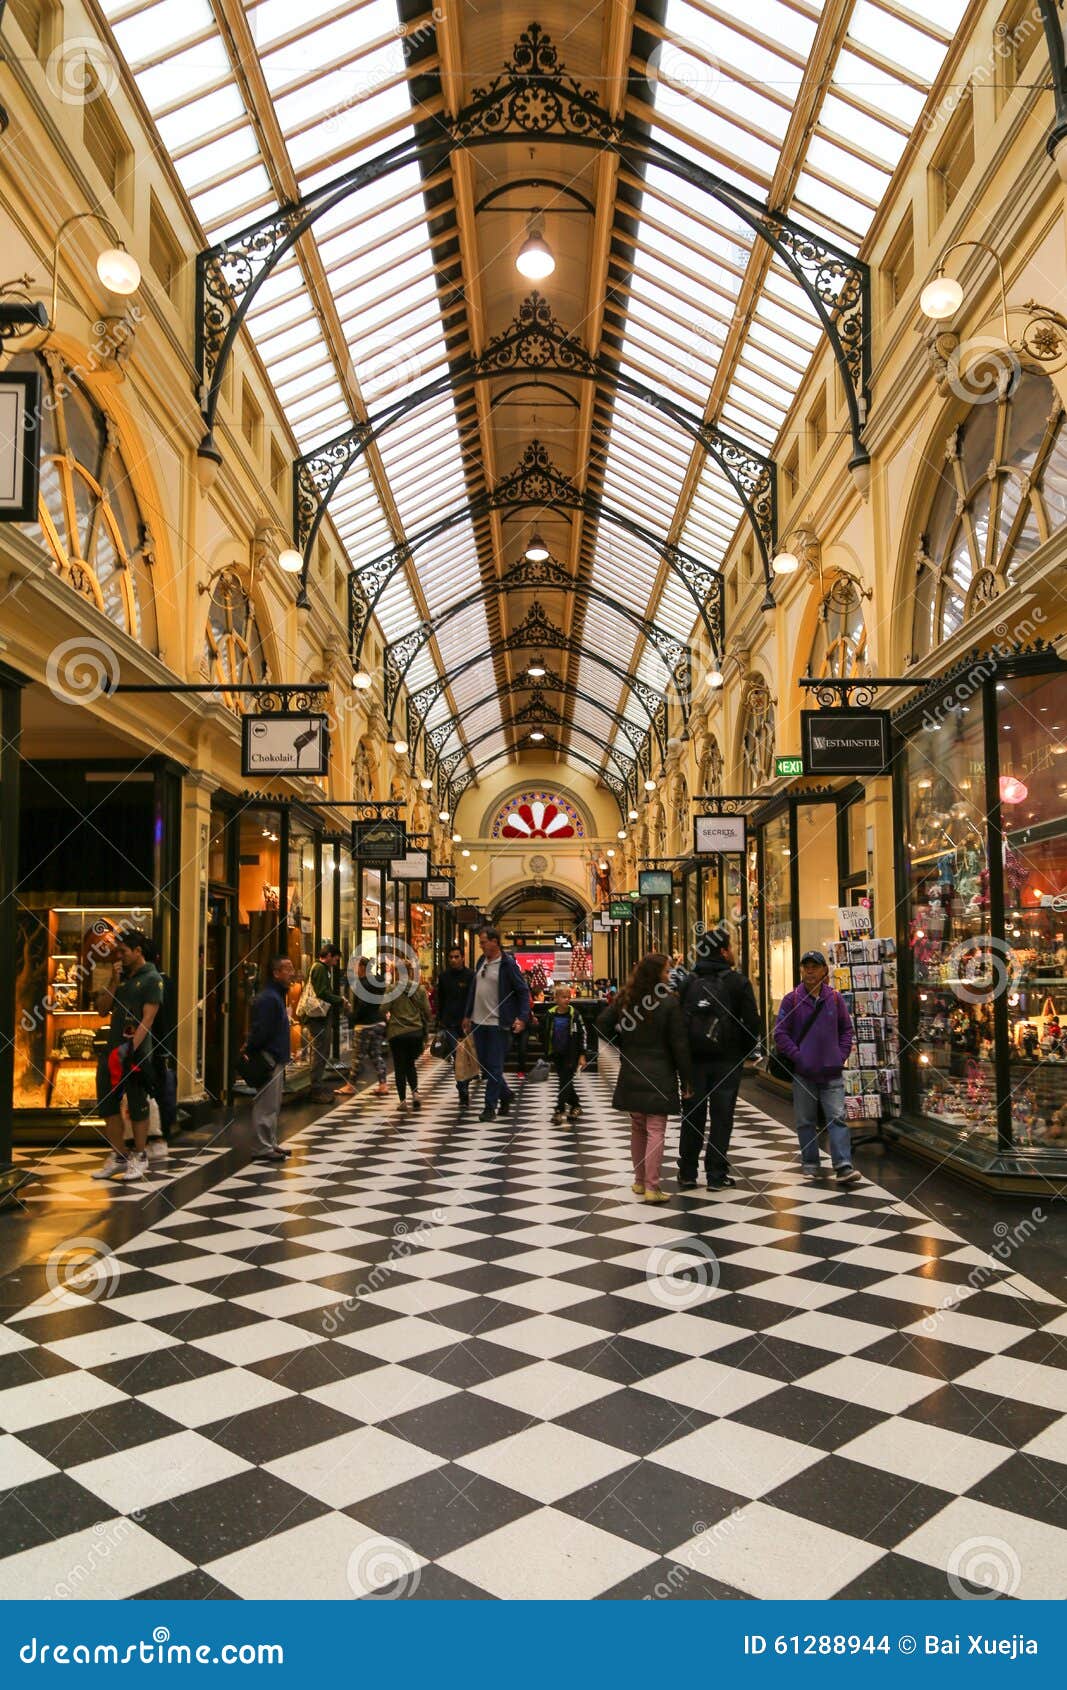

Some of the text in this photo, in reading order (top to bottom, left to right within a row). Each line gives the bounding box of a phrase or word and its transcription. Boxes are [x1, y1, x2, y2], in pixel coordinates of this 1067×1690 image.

[813, 736, 880, 750] WESTMINSTER
[251, 752, 296, 763] Chokolait.
[783, 761, 803, 773] EXIT
[702, 828, 735, 837] SECRETS
